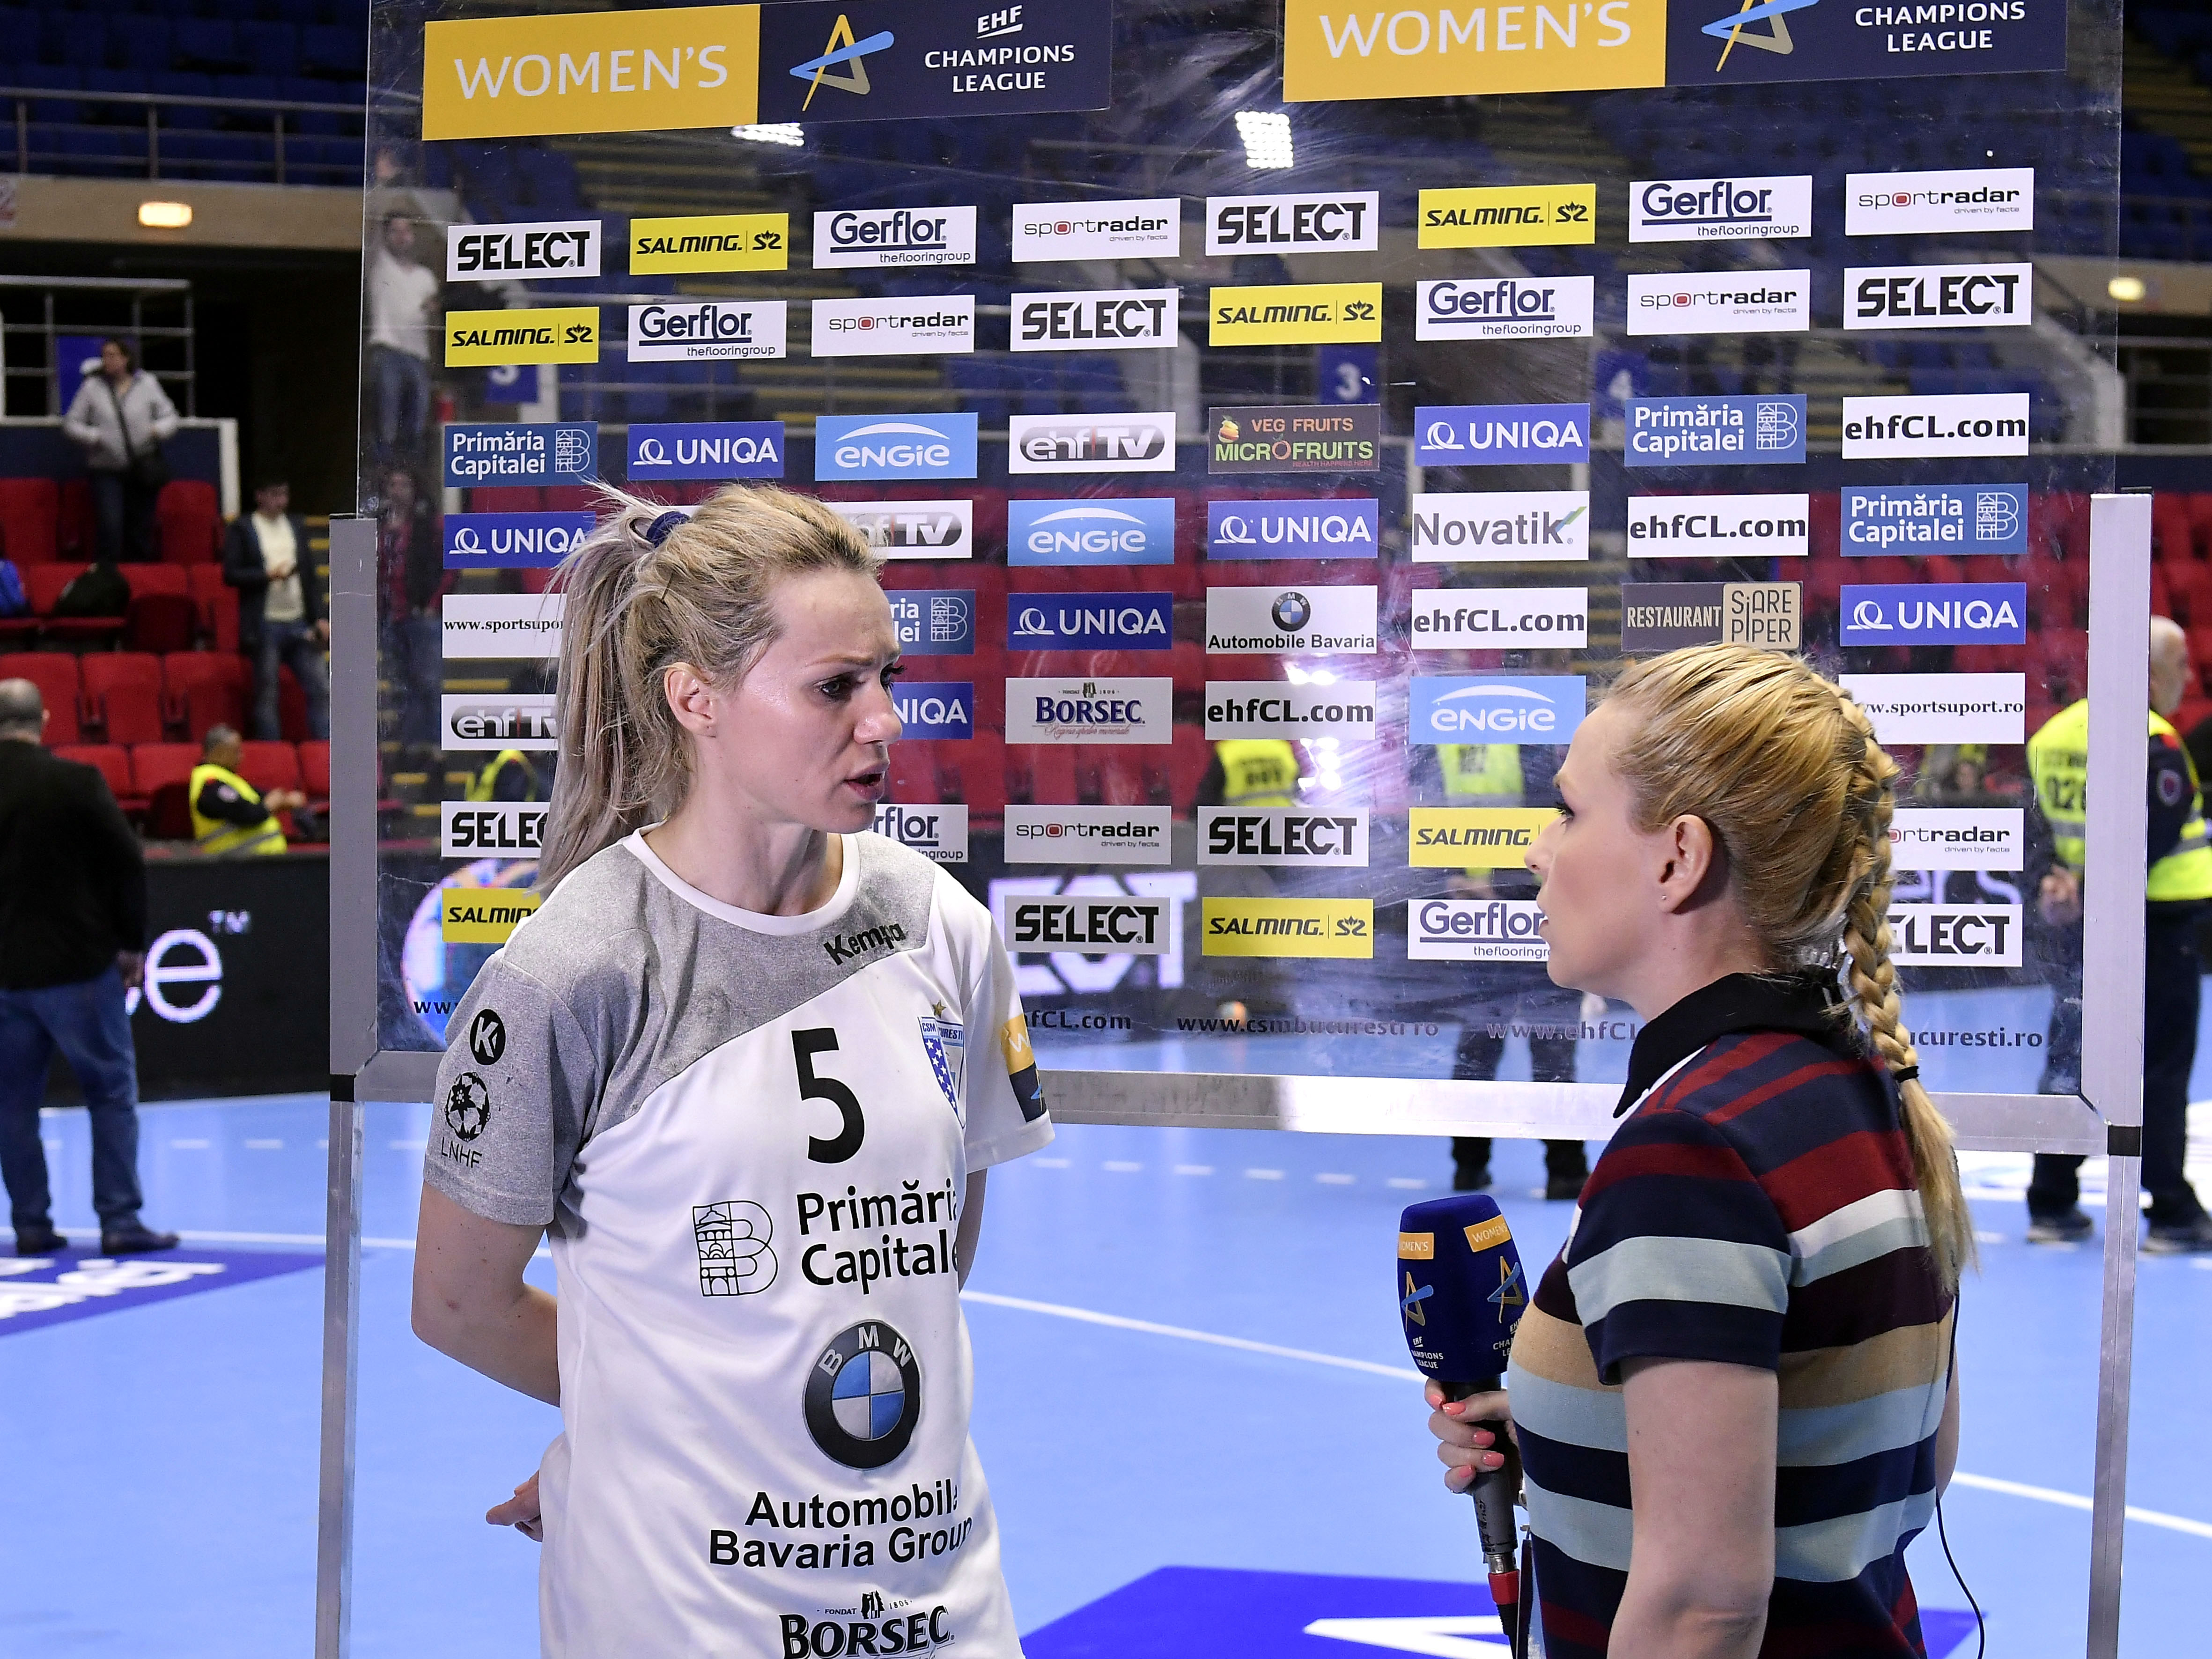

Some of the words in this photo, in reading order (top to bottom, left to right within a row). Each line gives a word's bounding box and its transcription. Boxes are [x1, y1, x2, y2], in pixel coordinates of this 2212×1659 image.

[977, 5, 1023, 34] EHF
[1855, 2, 2026, 27] CHAMPIONS
[1319, 1, 1631, 58] WOMEN'S
[1887, 30, 1993, 52] LEAGUE
[925, 44, 1075, 69] CHAMPIONS
[455, 45, 728, 99] WOMEN'S
[952, 72, 1046, 93] LEAGUE
[1642, 181, 1772, 217] Gerflor
[1858, 187, 2020, 210] sportradar
[830, 211, 947, 244] Gerflor
[1024, 216, 1168, 238] sportradar
[1218, 202, 1366, 244] SELECT
[1697, 223, 1799, 237] theflooringroup
[458, 231, 590, 272] SELECT
[879, 251, 971, 265] theflooringroup
[1428, 281, 1555, 317] Gerflor
[1640, 288, 1797, 310] sportradar
[1858, 275, 2019, 317] SELECT
[639, 305, 752, 339] Gerflor
[829, 312, 969, 333] sportradar
[1022, 299, 1167, 341] SELECT
[1482, 323, 1582, 336] theflooringroup
[687, 344, 776, 357] theflooringroup
[1252, 419, 1285, 432] VEG
[1293, 418, 1354, 432] FRUITS
[1634, 403, 1744, 429] Primăria
[1844, 415, 2027, 440] ehfCL.com
[453, 430, 545, 452] Primăria
[1469, 420, 1584, 449] UNIQA
[1632, 428, 1745, 458] Capitalei
[676, 437, 778, 465] UNIQA
[1215, 440, 1373, 461] MICROFRUITS
[450, 452, 545, 480] Capitalei
[1851, 493, 1963, 518] Primăria
[1261, 516, 1371, 543] UNIQA
[1413, 511, 1566, 546] Novatik
[1630, 514, 1806, 539] ehfCL.com
[1848, 518, 1964, 548] Capitalei
[444, 619, 563, 633] www.sportsupo
[1060, 608, 1166, 635] UNIQA
[1414, 608, 1585, 633] ehfCL.com
[1627, 606, 1721, 628] RESTAURANT
[1897, 600, 2019, 630] UNIQA
[1208, 634, 1305, 649] Automobile
[1311, 634, 1375, 649] Bavaria
[893, 698, 968, 724] NIQA
[1036, 697, 1142, 723] BORSEC
[1208, 699, 1373, 723] ehfCL.com
[1865, 701, 2023, 716] w.sportsuport.ro
[452, 811, 549, 848] SELE
[872, 806, 939, 842] rflor
[1016, 821, 1159, 839] sportradar
[1209, 817, 1357, 855] SELECT
[1015, 905, 1159, 944] SELECT
[824, 923, 906, 965] Kempa
[1474, 945, 1549, 959] theflooringr
[922, 1023, 936, 1032] CSM
[791, 1028, 865, 1164] 5
[442, 1136, 482, 1168] LNHF
[801, 1229, 959, 1294] Capital
[818, 1326, 912, 1377] BMW
[709, 1530, 875, 1569] Bavaria
[889, 1600, 909, 1609] 1806
[779, 1605, 952, 1659] BORSEC
